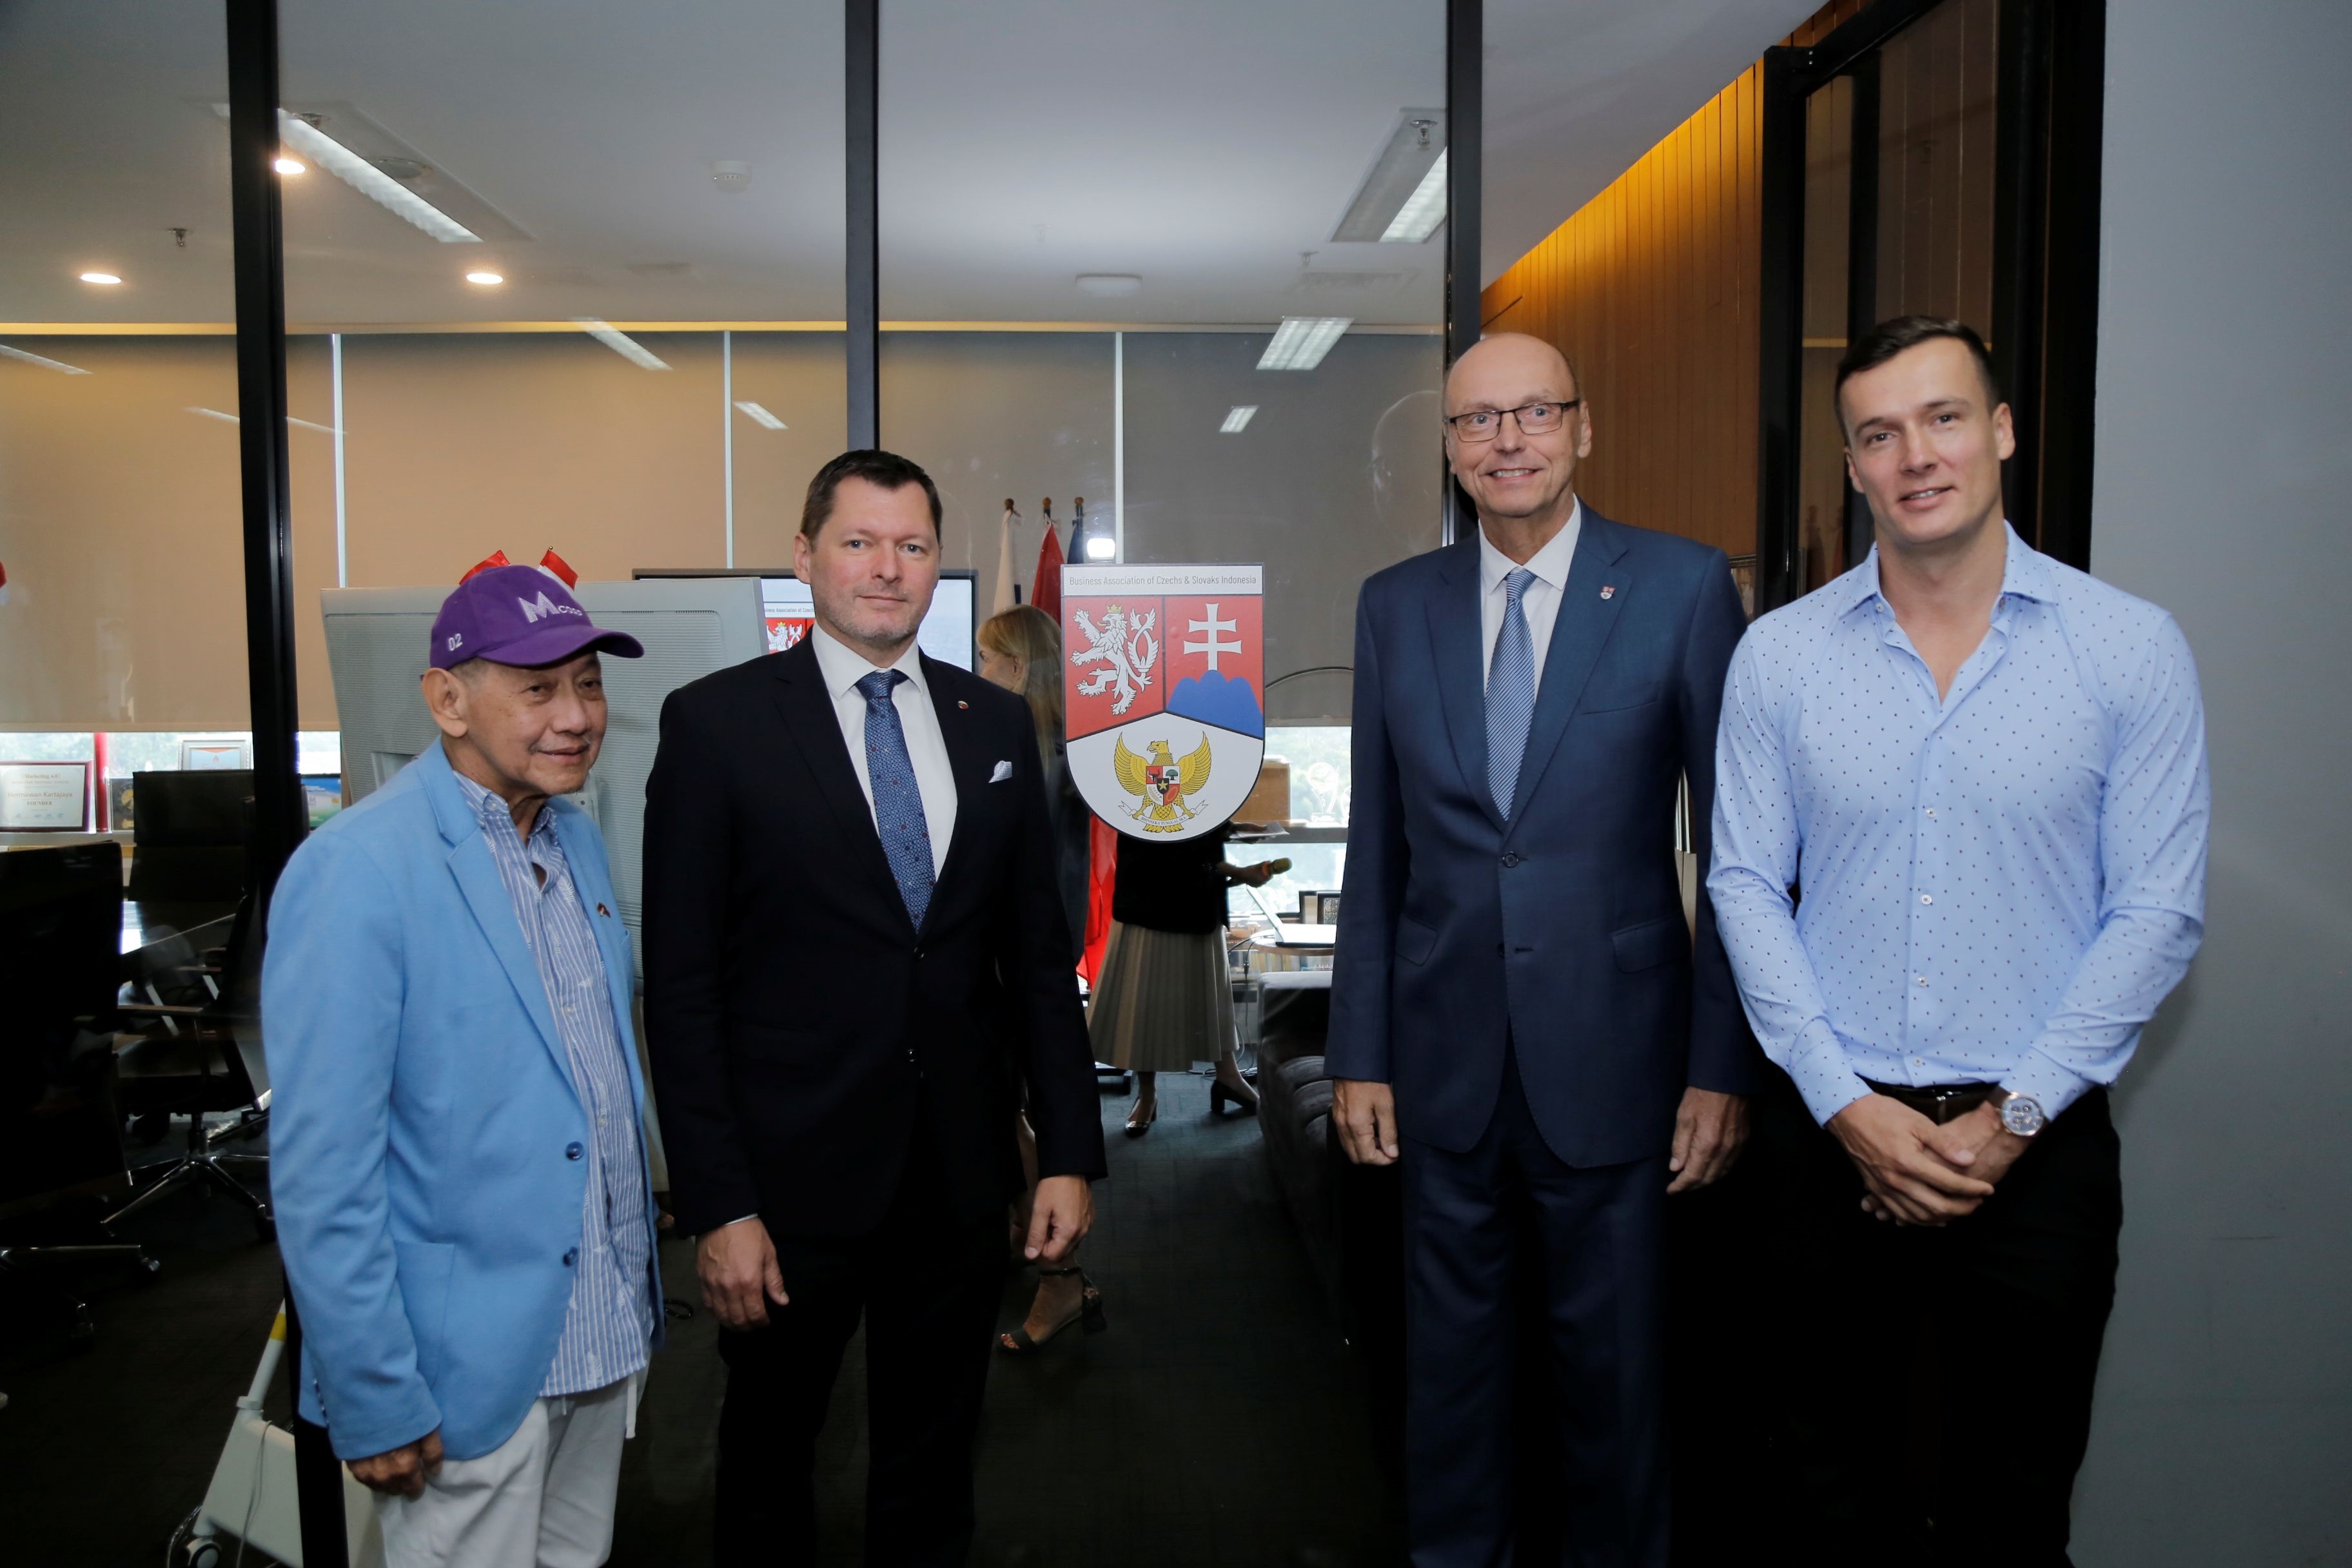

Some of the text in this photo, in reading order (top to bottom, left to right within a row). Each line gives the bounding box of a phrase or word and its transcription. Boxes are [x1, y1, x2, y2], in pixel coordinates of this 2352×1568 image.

[1070, 575, 1257, 585] Business Association of Czechs & Slovaks Indonesia
[448, 633, 463, 651] 02
